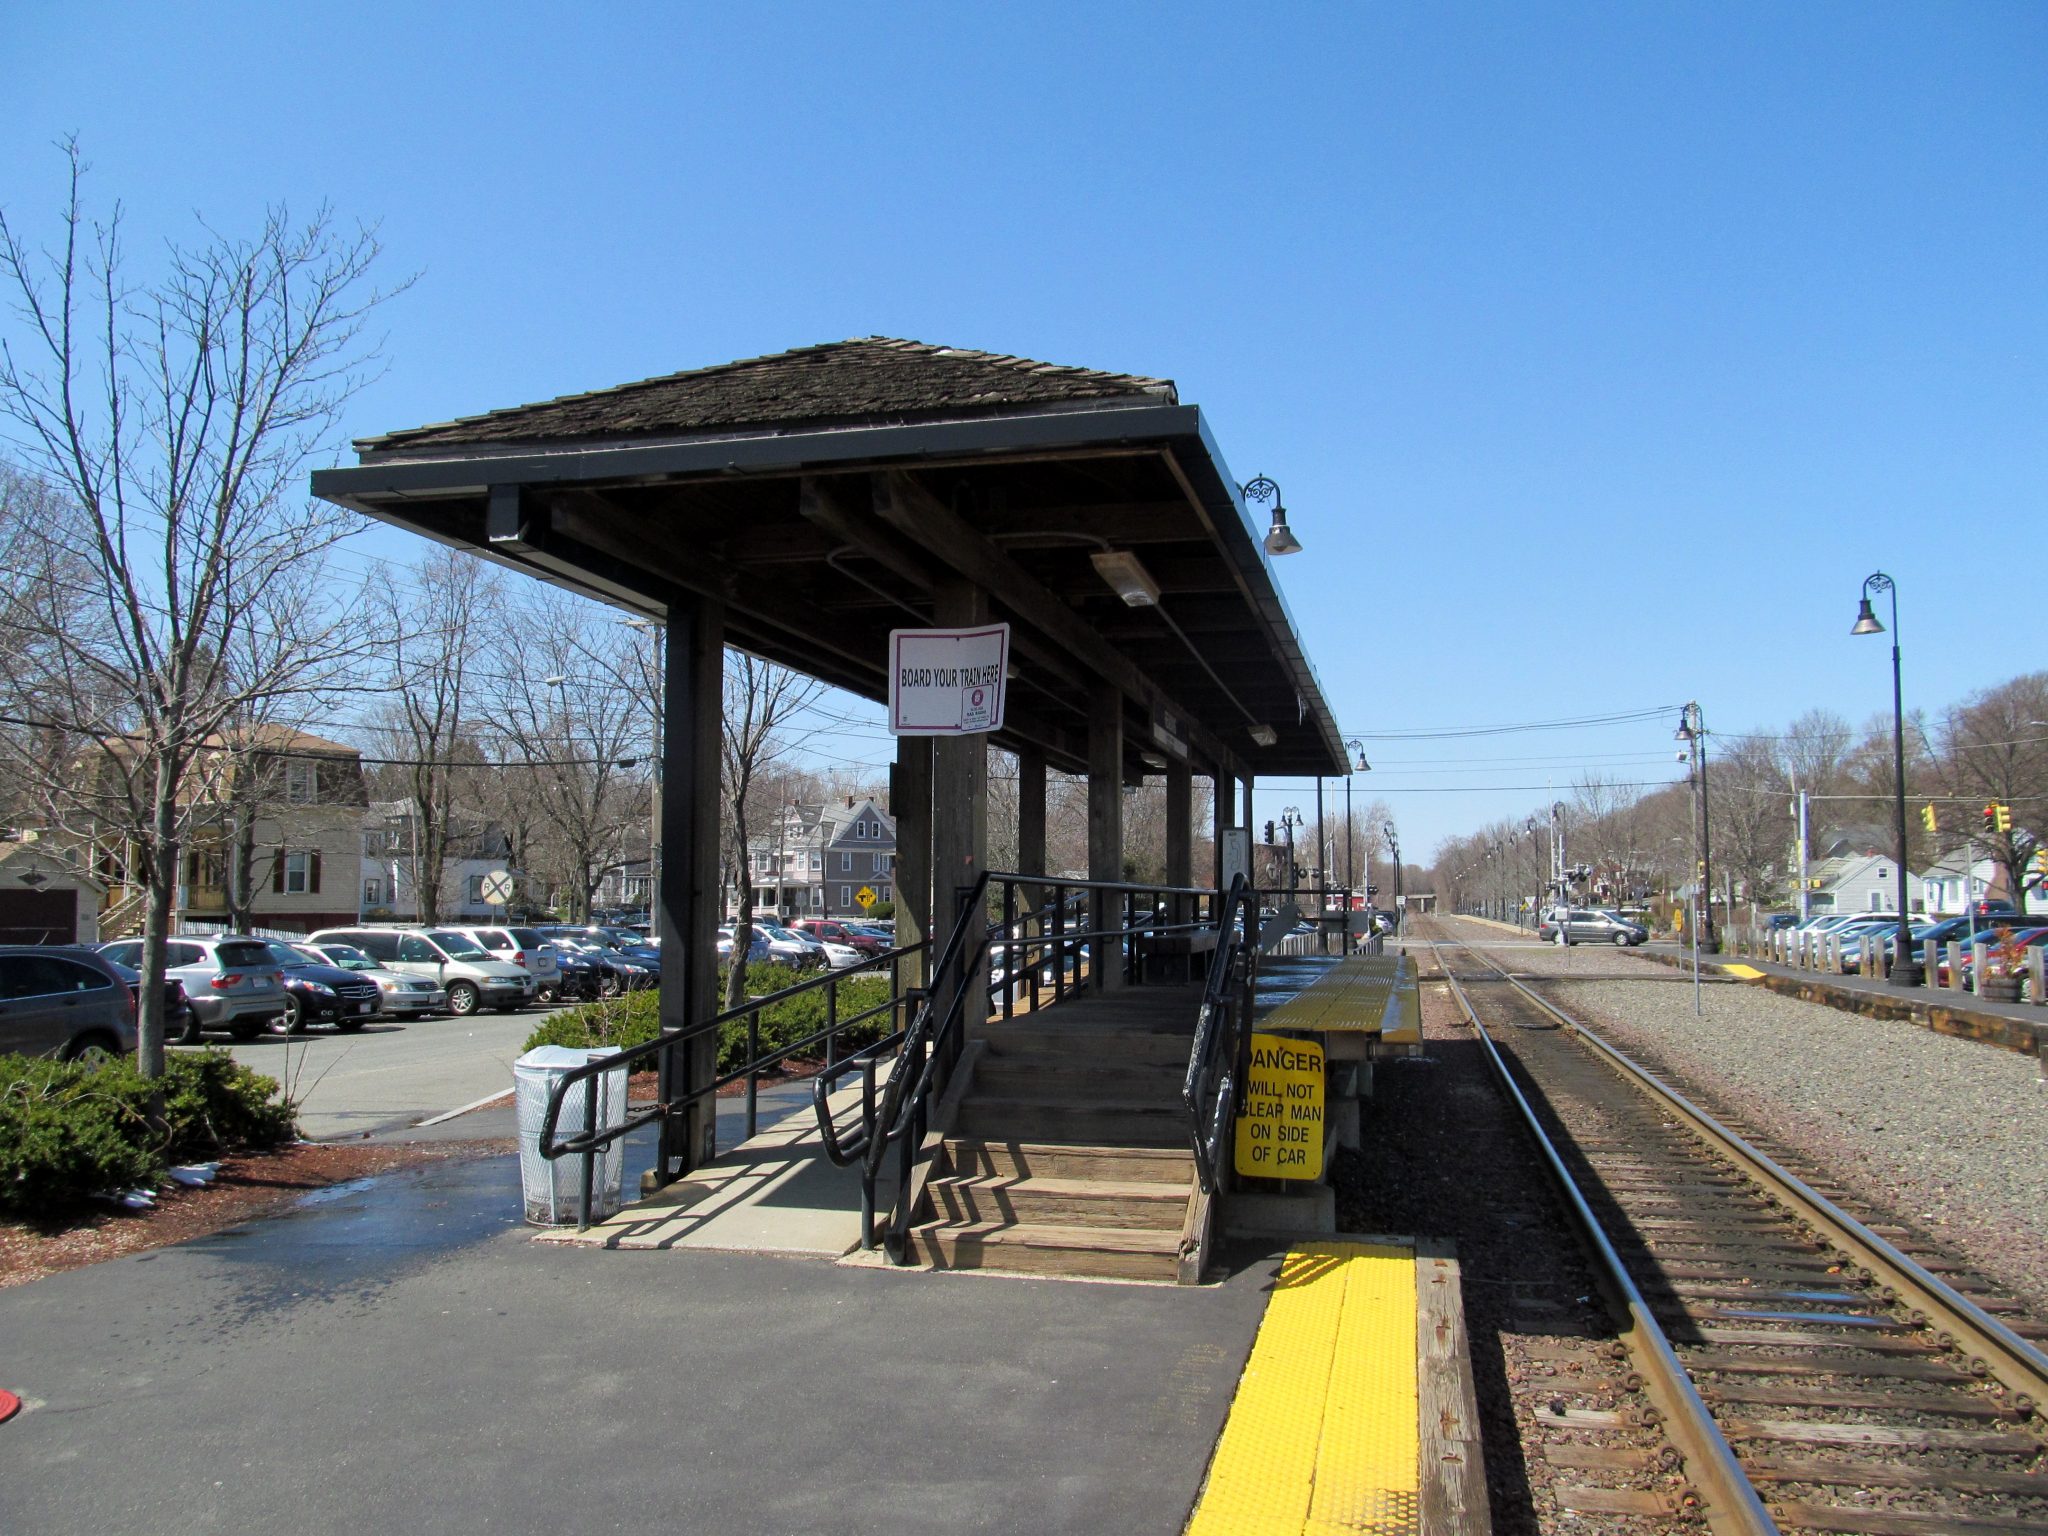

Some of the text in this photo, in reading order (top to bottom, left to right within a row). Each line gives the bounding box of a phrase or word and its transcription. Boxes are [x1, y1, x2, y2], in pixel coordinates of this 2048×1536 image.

[901, 664, 999, 687] BOARD YOUR TRAIN HERE
[484, 882, 511, 892] R R
[1250, 1048, 1321, 1073] ANGER
[1248, 1080, 1315, 1099] WILL NOT
[1246, 1101, 1321, 1121] LEAR MAN
[1250, 1123, 1310, 1143] ON SIDE
[1252, 1146, 1306, 1165] OF CAR
